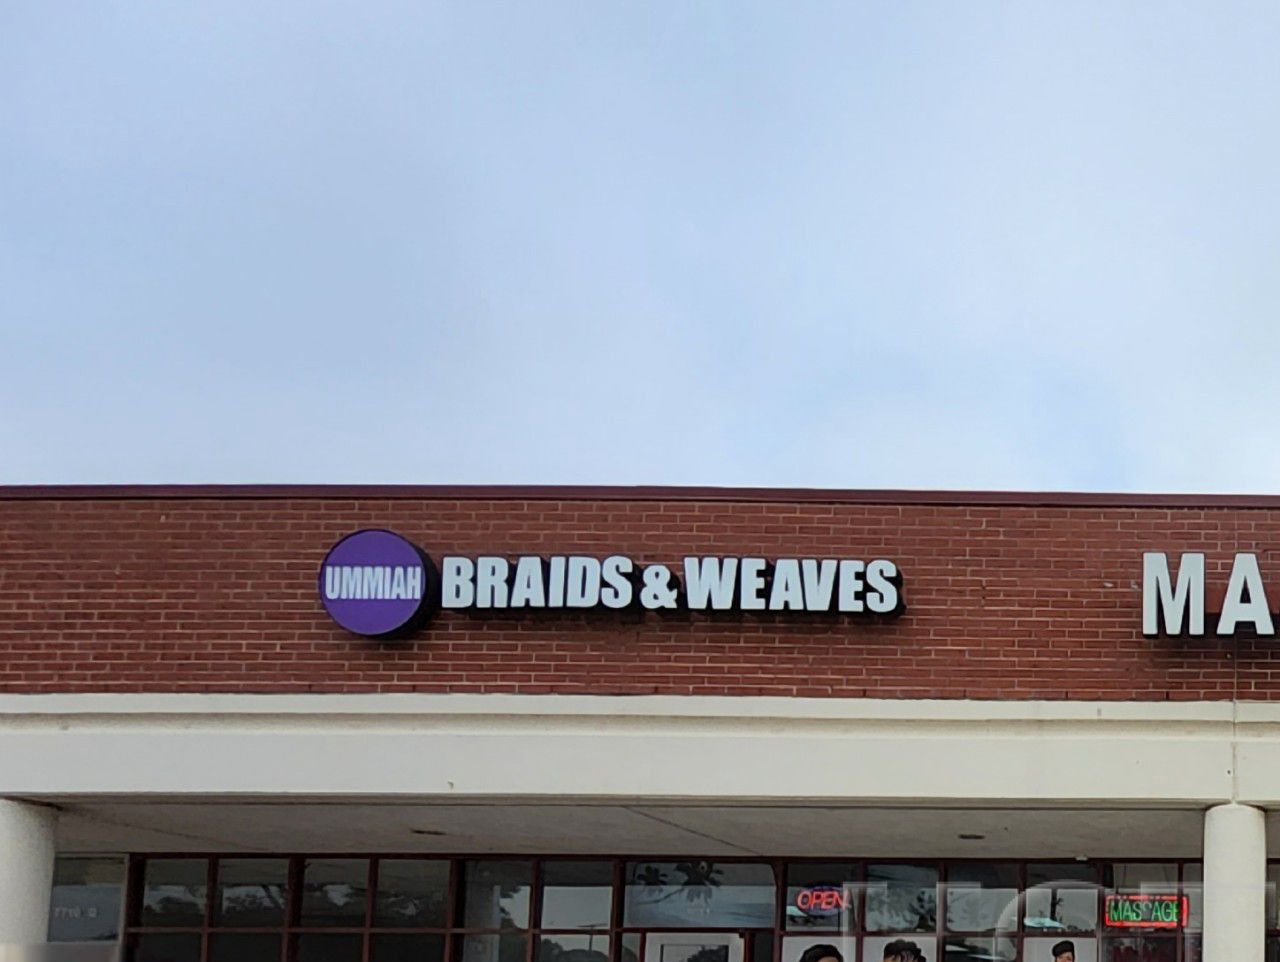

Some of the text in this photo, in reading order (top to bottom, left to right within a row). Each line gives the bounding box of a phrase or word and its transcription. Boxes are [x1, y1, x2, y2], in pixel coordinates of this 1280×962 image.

[325, 566, 422, 600] UMMIAH
[441, 556, 898, 614] BRAIDS & WEAVES
[797, 889, 850, 912] OPEN
